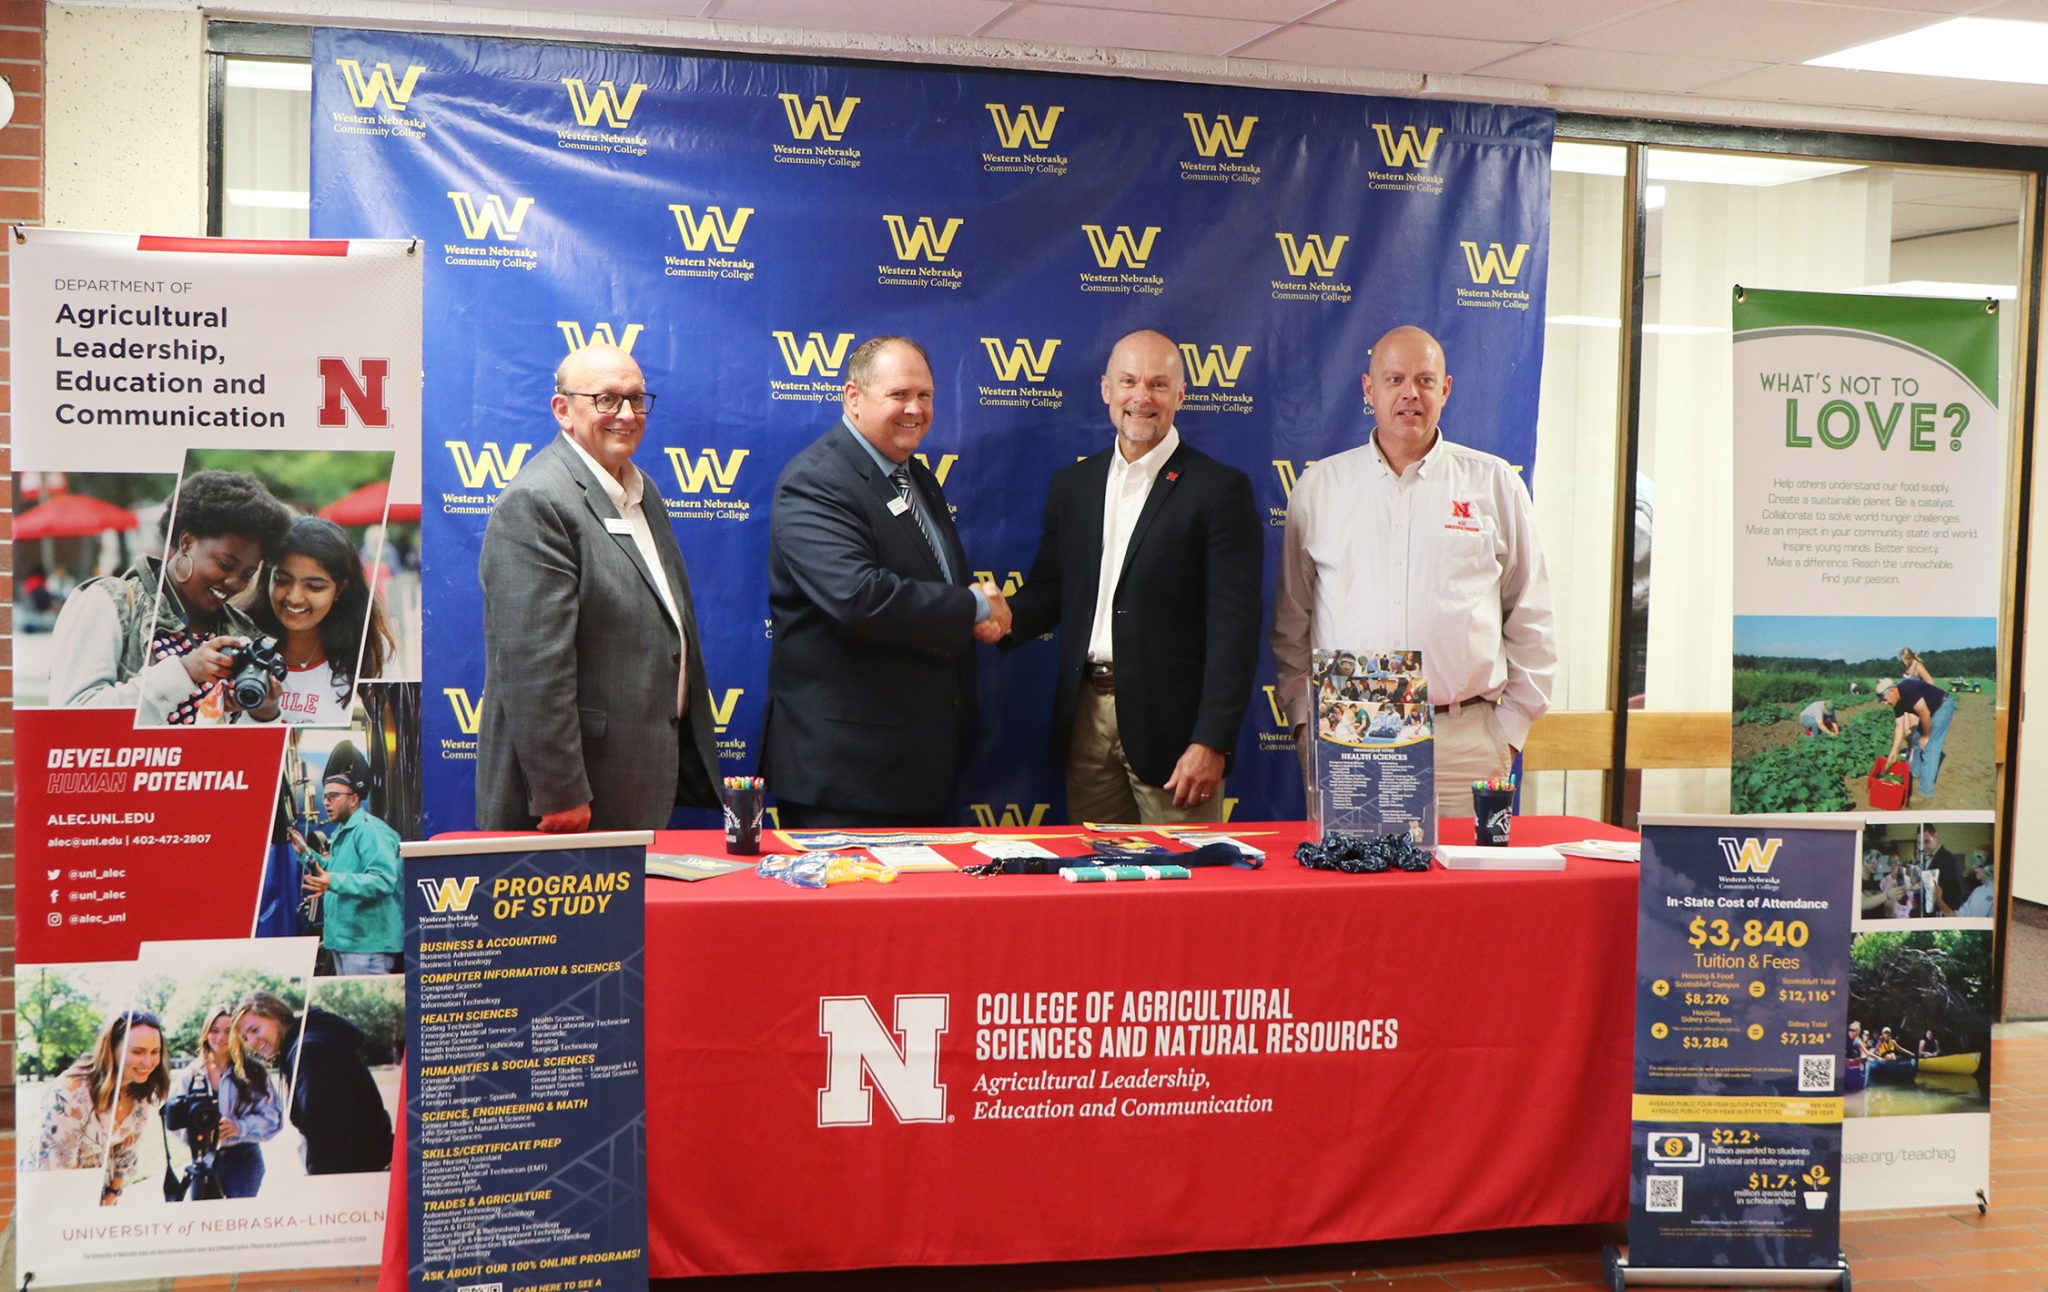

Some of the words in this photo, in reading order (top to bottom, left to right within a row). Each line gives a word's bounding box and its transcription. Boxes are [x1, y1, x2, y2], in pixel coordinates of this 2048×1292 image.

[333, 112, 375, 124] Western
[378, 115, 426, 129] Nebraska
[334, 124, 389, 138] Community
[392, 127, 426, 140] College
[1368, 171, 1404, 180] Western
[1406, 173, 1444, 185] Nebraska
[1368, 182, 1416, 193] Community
[1416, 183, 1443, 196] College
[664, 256, 705, 267] Western
[708, 258, 755, 270] Nebraska
[665, 267, 719, 280] Community
[721, 269, 754, 281] College
[1080, 273, 1118, 282] Western
[1120, 274, 1164, 285] Nebraska
[55, 279, 165, 293] DEPARTMENT
[170, 282, 193, 294] OF
[1080, 283, 1131, 295] Community
[1132, 284, 1164, 296] College
[1456, 288, 1490, 298] Western
[1491, 290, 1530, 300] Nebraska
[1456, 298, 1502, 310] Community
[1502, 300, 1530, 311] College
[55, 303, 228, 328] Agricultural
[56, 337, 226, 365] Leadership,
[56, 370, 203, 393] Education
[213, 374, 265, 394] and
[1760, 372, 1832, 394] WHAT'S
[1840, 376, 1882, 396] NOT
[1891, 378, 1920, 397] TO
[317, 356, 390, 428] N
[55, 403, 285, 427] Communication
[1785, 398, 1971, 452] LOVE?
[1828, 480, 1880, 491] understand
[1452, 500, 1472, 518] N
[47, 747, 182, 769] DEVELOPING
[47, 772, 128, 793] HUMAN
[133, 770, 249, 792] POTENTIAL
[48, 812, 155, 826] ALEC.UNL.EDU
[48, 835, 122, 848] alec@unl.edu
[132, 834, 211, 846] 402-472-2807
[68, 868, 126, 880] @unl_alec
[492, 871, 630, 898] PROGRAMS
[68, 890, 126, 902] @unl_alec
[1666, 896, 1716, 908] In-State
[1718, 897, 1744, 909] Cost
[1746, 897, 1759, 909] of
[1762, 898, 1829, 910] Attendance
[494, 898, 526, 920] OF
[531, 894, 612, 918] STUDY
[68, 912, 126, 925] @alec_unl
[1688, 915, 1809, 951] $3,840
[420, 940, 474, 952] BUSINESS
[476, 939, 484, 948] &
[486, 935, 557, 948] ACCOUNTING
[1694, 952, 1745, 968] Tuition
[1748, 954, 1760, 969] &
[1763, 954, 1800, 970] Fees
[421, 972, 482, 984] COMPUTER
[484, 966, 558, 980] INFORMATION
[560, 966, 568, 975] &
[571, 962, 622, 974] SCIENCES
[976, 991, 1078, 1026] COLLEGE
[1085, 990, 1114, 1024] OF
[1120, 988, 1293, 1024] AGRICULTURAL
[1685, 992, 1730, 1006] $8,276
[421, 1010, 464, 1024] HEALTH
[466, 1008, 518, 1021] SCIENCES
[975, 1026, 1092, 1061] SCIENCES
[1099, 1026, 1148, 1059] AND
[1154, 1023, 1259, 1057] NATURAL
[1266, 1018, 1398, 1054] RESOURCES
[1683, 1036, 1728, 1050] $3,284
[421, 1062, 489, 1077] HUMANITIES
[492, 1061, 499, 1070] &
[502, 1058, 540, 1070] SOCIAL
[543, 1054, 596, 1068] SCIENCES
[817, 993, 950, 1128] N
[973, 1069, 1096, 1096] Agricultural
[1099, 1068, 1211, 1092] Leadership,
[422, 1109, 470, 1122] SCIENCE,
[472, 1102, 544, 1117] ENGINEERING
[546, 1102, 554, 1112] &
[556, 1098, 588, 1110] MATH
[973, 1099, 1074, 1121] Education
[1079, 1097, 1116, 1118] and
[1121, 1094, 1274, 1118] Communication
[1711, 1127, 1760, 1146] $2.2+
[422, 1140, 532, 1158] SKILLS/CERTIFICATE
[533, 1138, 562, 1150] PREP
[1708, 1146, 1734, 1155] million
[1735, 1147, 1766, 1156] awarded
[1777, 1148, 1810, 1156] students
[1841, 1147, 1956, 1166] aae.org/teachag
[1716, 1157, 1742, 1165] federal
[1744, 1158, 1758, 1166] and
[1779, 1158, 1805, 1168] grants
[1749, 1174, 1797, 1190] $1.7+
[424, 1198, 466, 1212] TRADES
[468, 1197, 475, 1207] &
[479, 1190, 552, 1206] AGRICULTURE
[1746, 1198, 1796, 1206] scholarships
[1762, 1190, 1796, 1198] awarded
[62, 1222, 173, 1242] UNIVERSITY
[178, 1220, 196, 1238] of
[422, 1270, 445, 1282] ASK
[446, 1266, 483, 1280] ABOUT
[486, 1262, 508, 1274] OUR
[511, 1260, 536, 1272] 100%
[540, 1255, 578, 1268] ONLINE
[580, 1249, 640, 1264] PROGRAMS!
